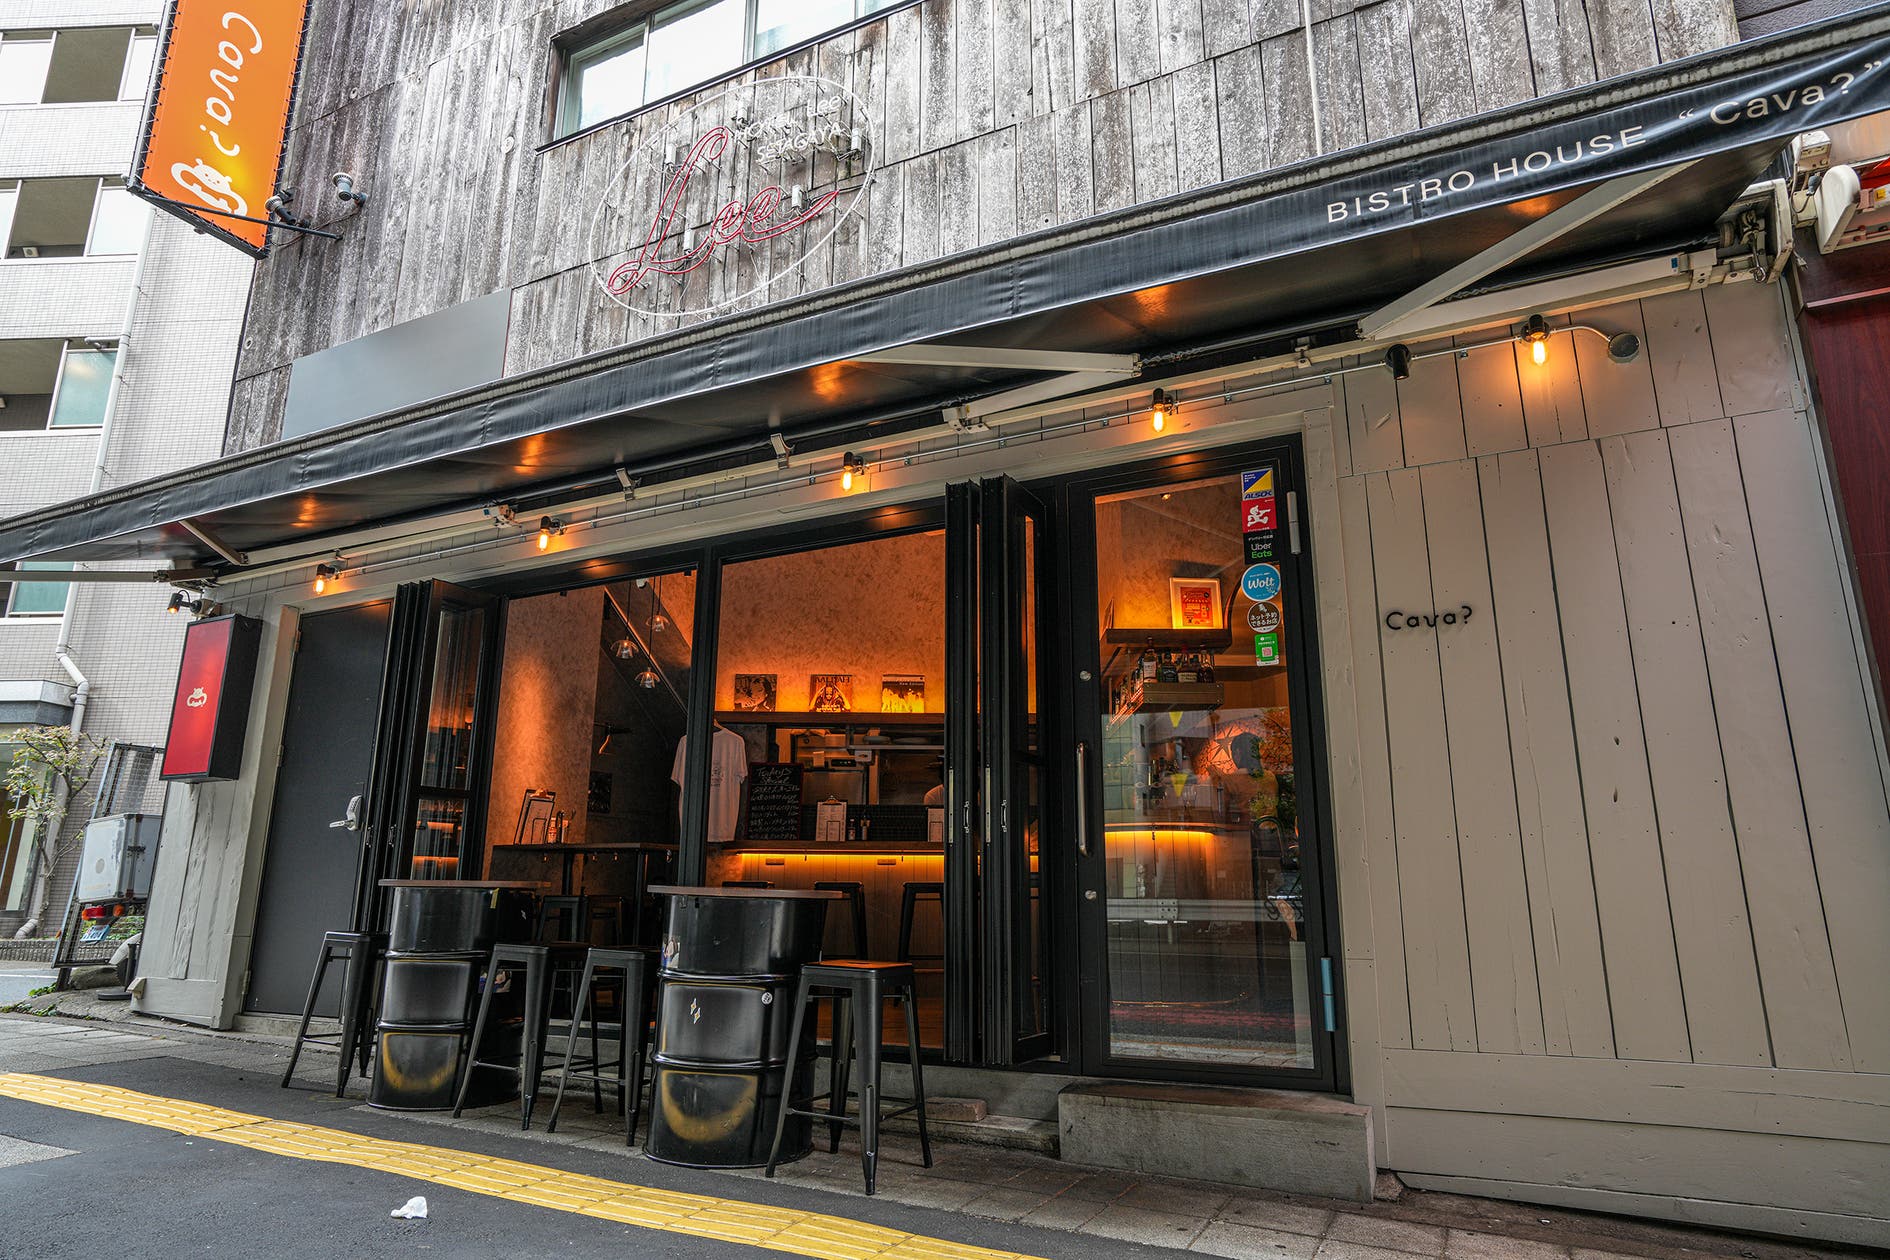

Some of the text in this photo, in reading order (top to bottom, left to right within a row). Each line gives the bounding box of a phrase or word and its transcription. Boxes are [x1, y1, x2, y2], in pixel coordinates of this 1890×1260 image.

[200, 11, 263, 157] Cava?
[1327, 125, 1647, 224] BISTRO HOUSE
[607, 126, 840, 296] Lee
[1250, 543, 1272, 551] Uber
[1251, 550, 1273, 559] Eats
[1248, 577, 1275, 590] Wolt
[1386, 605, 1473, 631] Cava?
